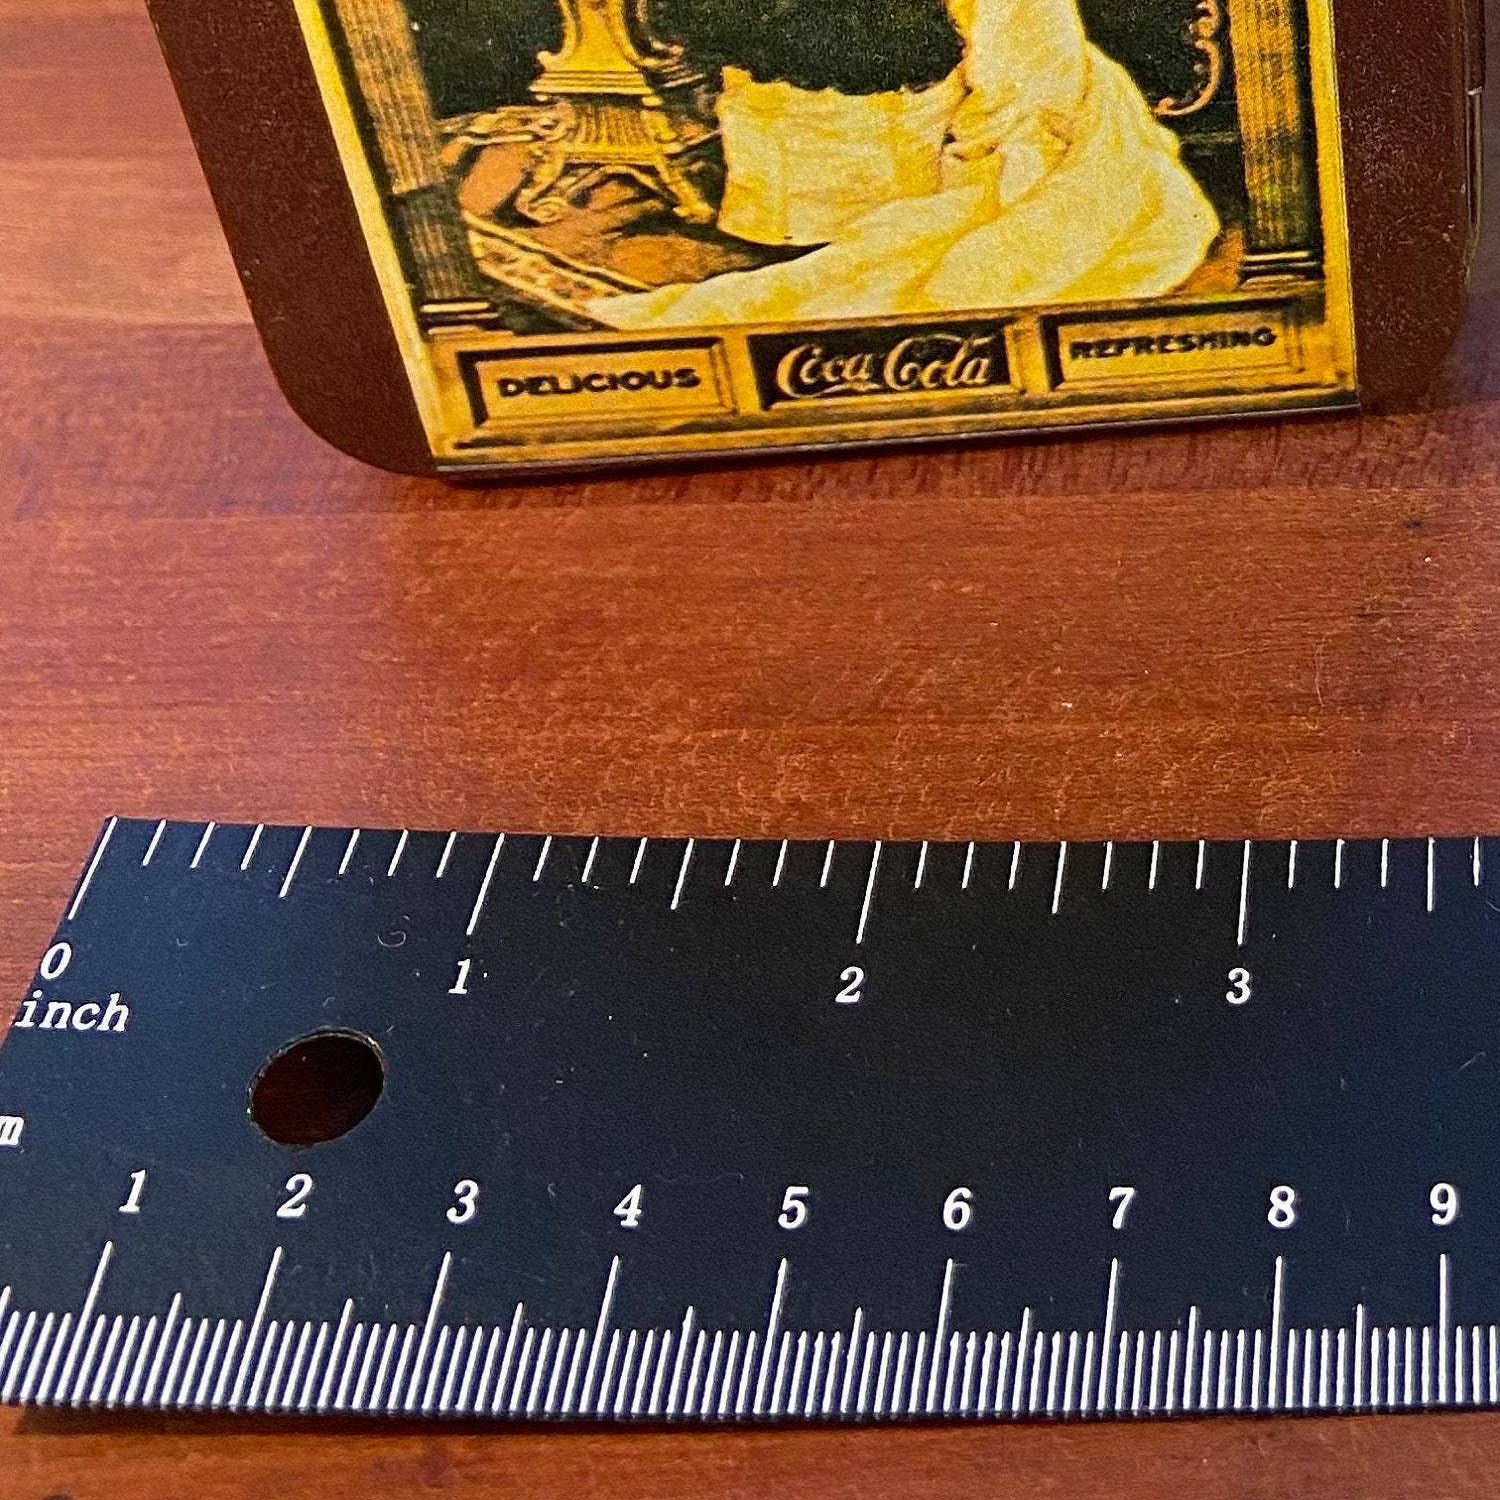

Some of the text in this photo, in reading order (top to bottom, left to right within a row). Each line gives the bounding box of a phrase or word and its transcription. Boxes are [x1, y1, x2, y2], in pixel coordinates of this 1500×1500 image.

[1068, 325, 1279, 361] REFRESHING
[497, 366, 701, 398] DELICIOUS
[40, 942, 72, 980] 0
[448, 958, 472, 996] 1
[834, 966, 865, 1004] 2
[1225, 967, 1251, 1005] 3
[14, 992, 131, 1032] inch
[118, 1169, 146, 1214] 1
[276, 1173, 313, 1219] 2
[446, 1179, 480, 1225] 3
[613, 1184, 642, 1228] 4
[777, 1185, 809, 1230] 5
[942, 1187, 973, 1231] 6
[1108, 1186, 1135, 1230] 7
[1267, 1185, 1296, 1229] 8
[1429, 1182, 1458, 1226] 9
